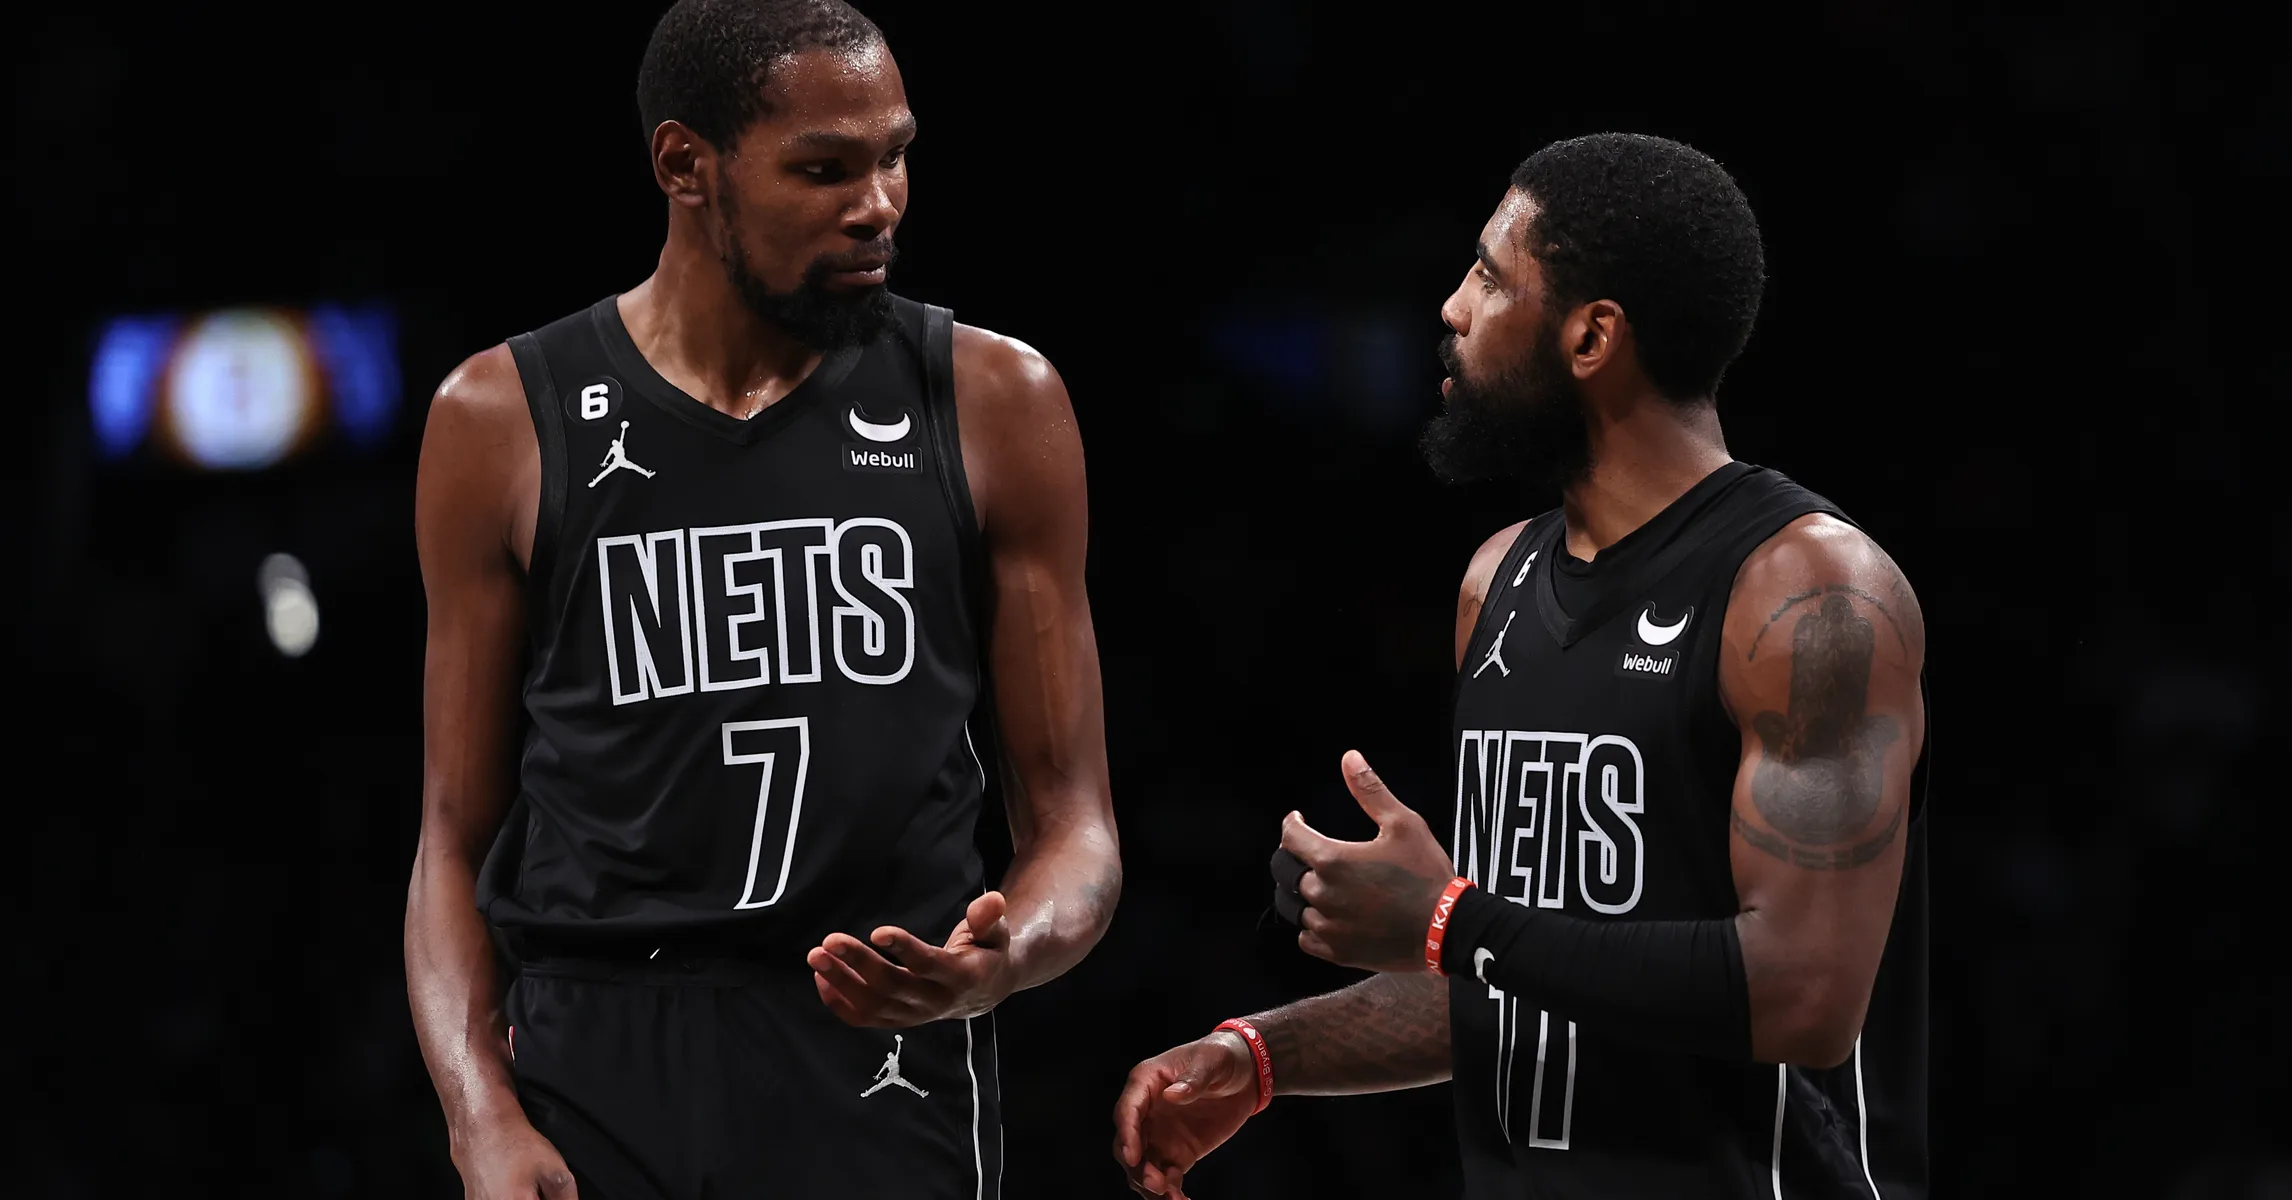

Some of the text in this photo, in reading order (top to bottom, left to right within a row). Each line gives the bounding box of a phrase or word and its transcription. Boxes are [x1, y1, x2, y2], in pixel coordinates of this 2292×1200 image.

[581, 383, 609, 421] 6
[850, 450, 914, 470] Webull
[1512, 550, 1539, 588] 6
[597, 517, 915, 706] NETS
[1622, 652, 1673, 675] Webull
[720, 716, 810, 910] 7
[1453, 730, 1645, 915] NETS
[1432, 895, 1455, 930] KAI
[1255, 1039, 1271, 1076] Bryant
